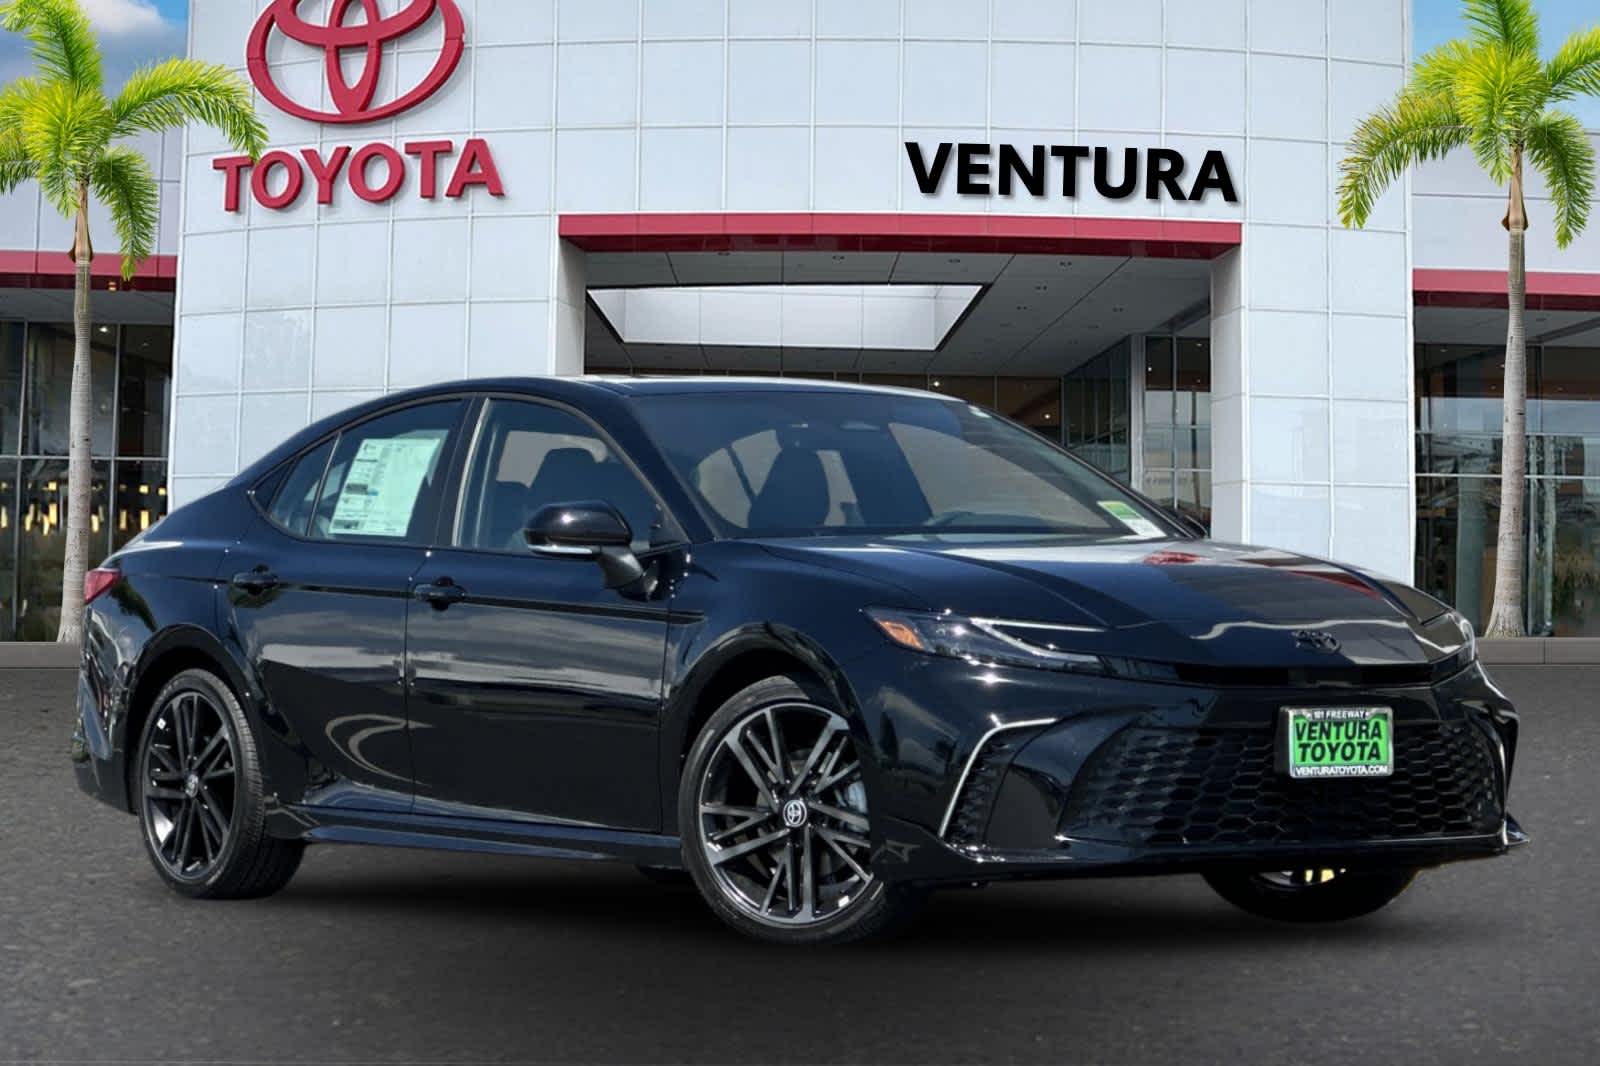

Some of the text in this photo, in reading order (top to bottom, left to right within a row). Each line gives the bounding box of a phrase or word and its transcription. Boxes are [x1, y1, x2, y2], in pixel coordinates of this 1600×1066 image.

[213, 138, 505, 212] TOYOTA
[904, 141, 1239, 203] VENTURA
[1326, 710, 1365, 719] FREEWAY
[1295, 721, 1382, 740] VENTURA
[1298, 742, 1381, 762] TOYOTA
[1295, 765, 1388, 776] VENTURATOYOTA.COM
